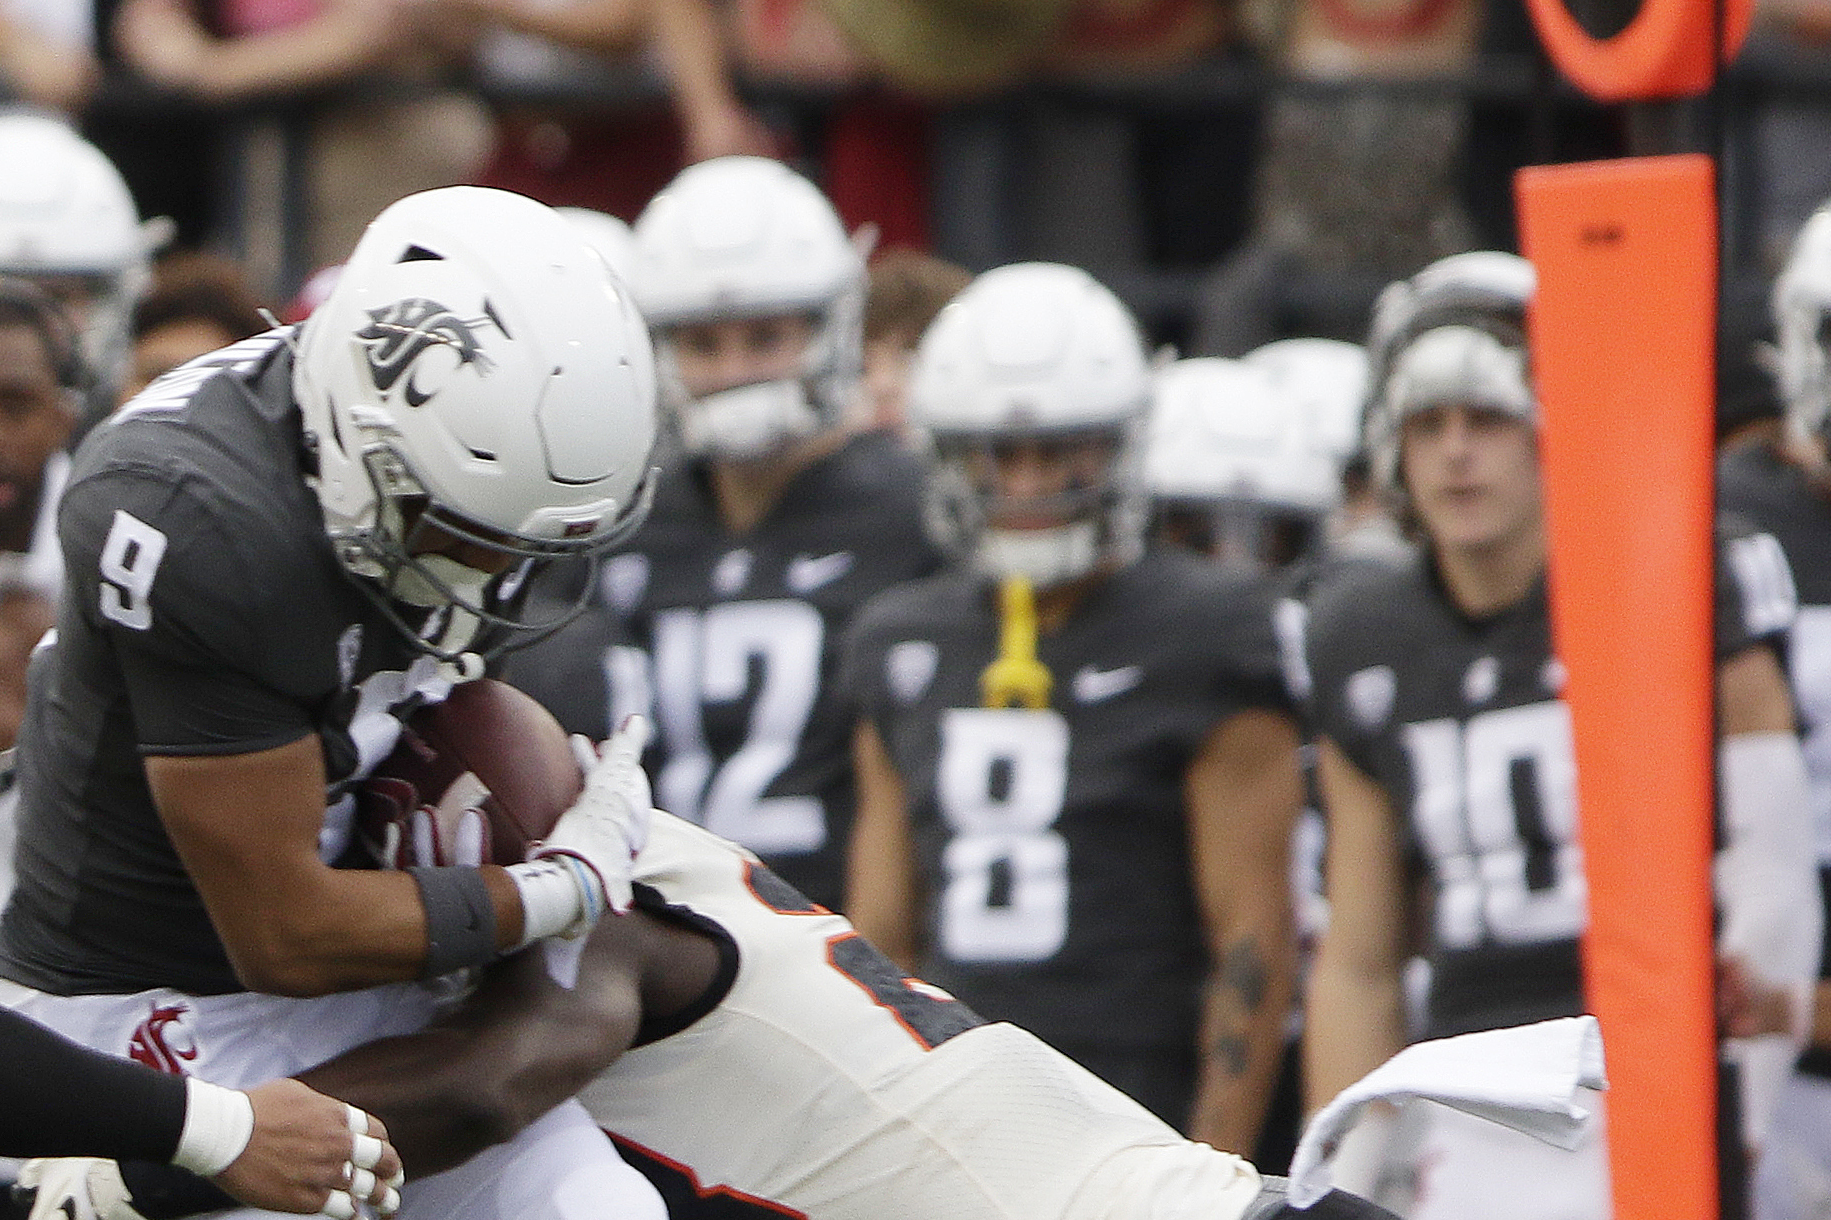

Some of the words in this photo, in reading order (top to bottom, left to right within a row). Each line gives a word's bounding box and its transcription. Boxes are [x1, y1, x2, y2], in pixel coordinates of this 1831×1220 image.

[98, 508, 168, 631] 9
[653, 599, 826, 853] 12
[937, 706, 1072, 962] 8
[1398, 698, 1592, 948] 10
